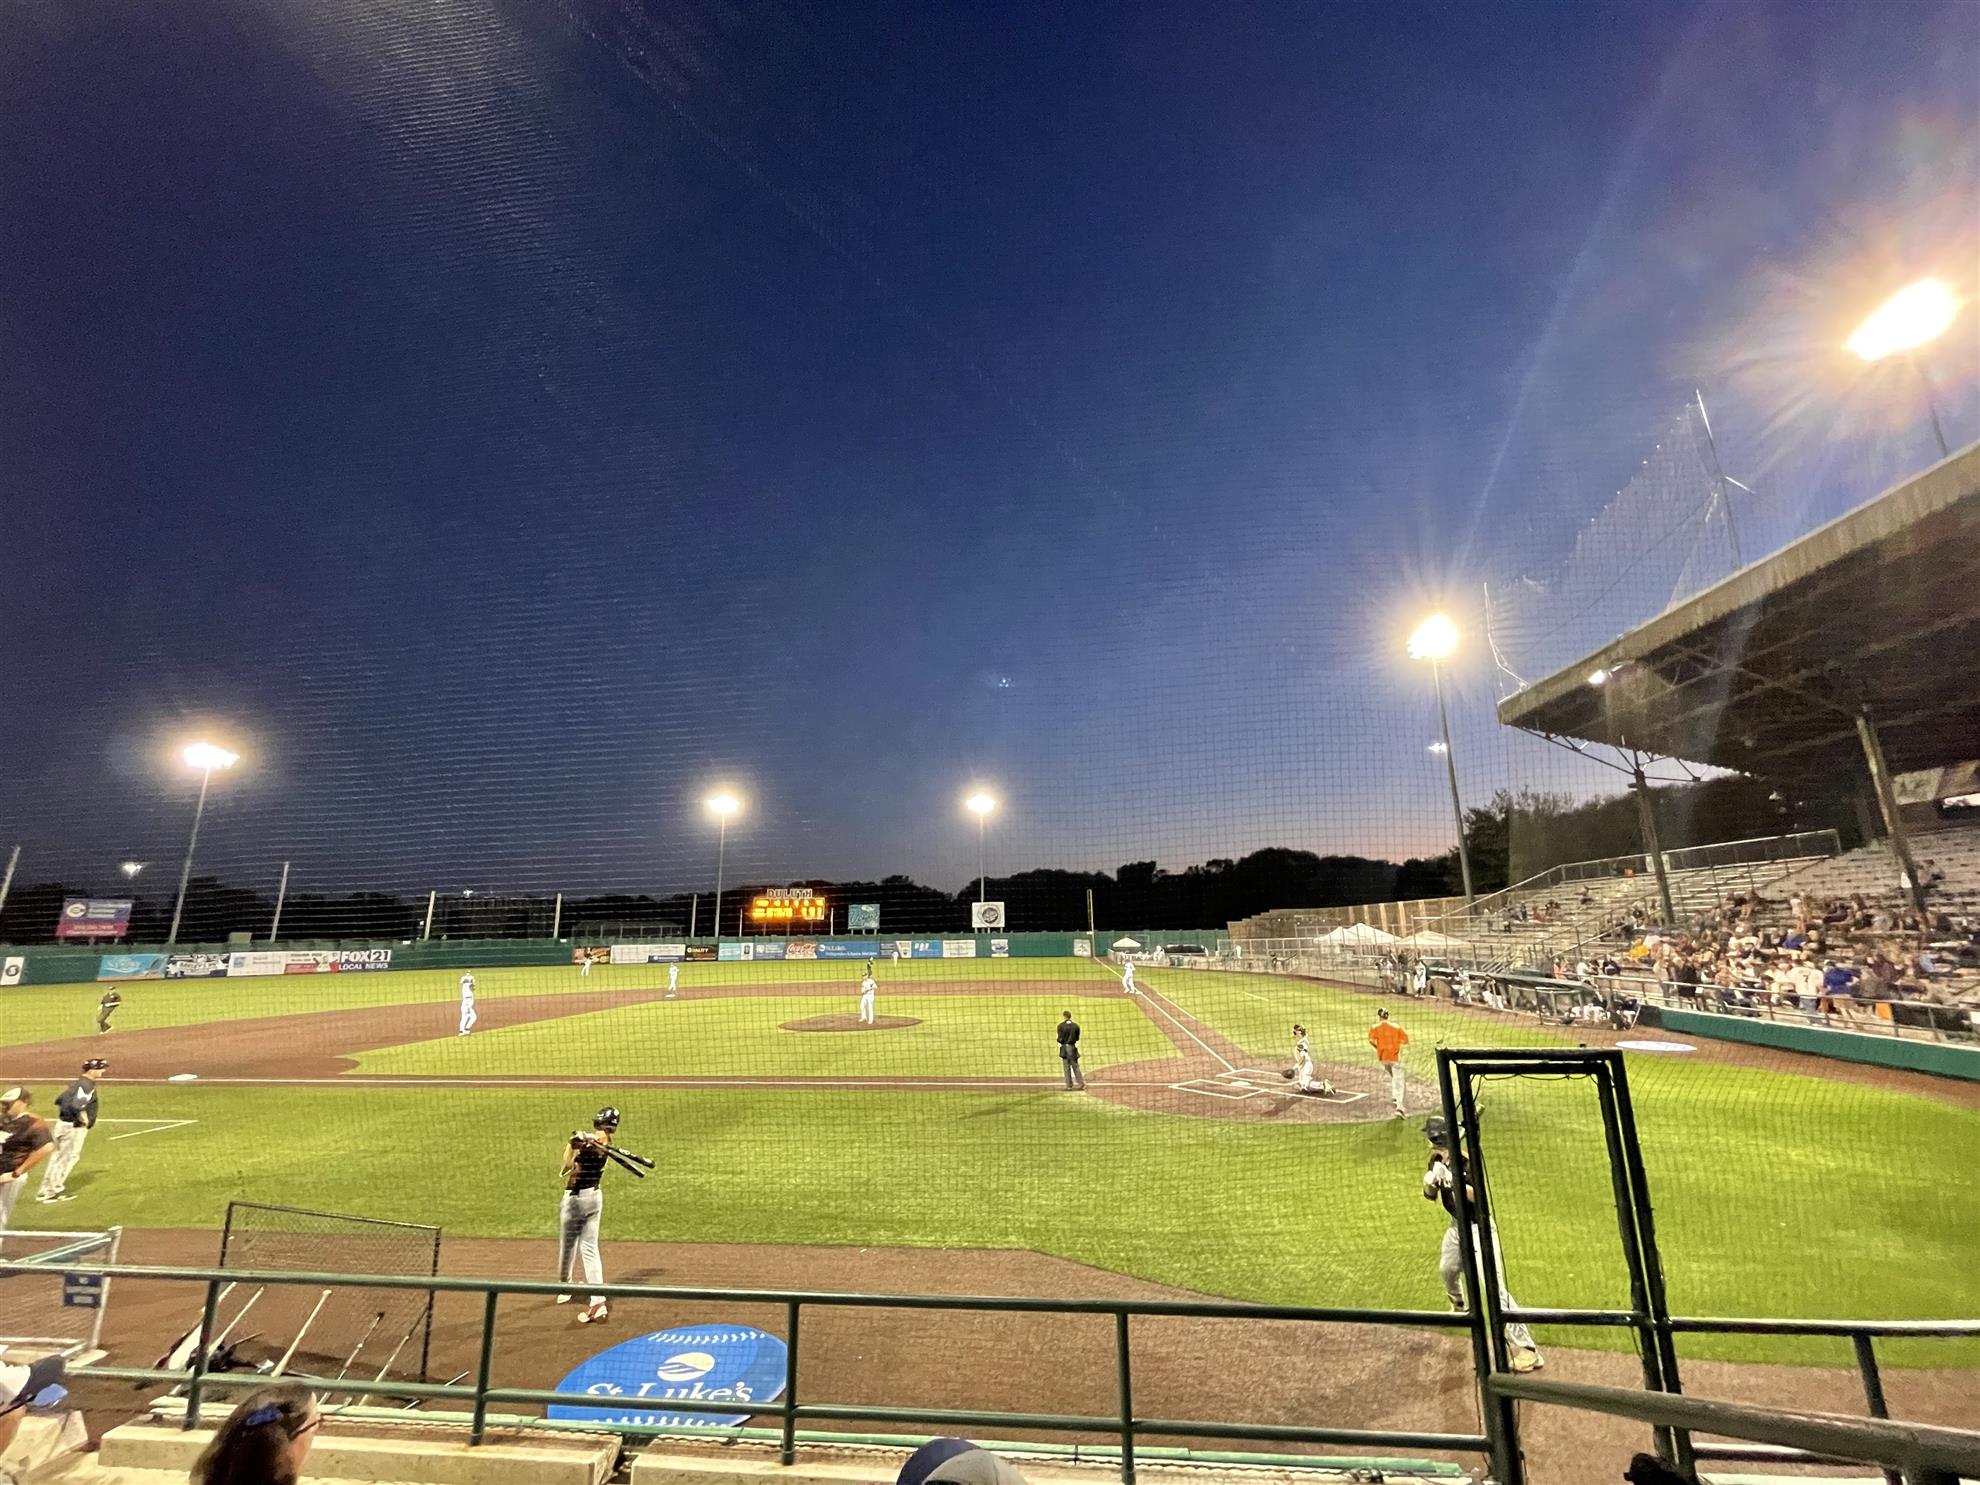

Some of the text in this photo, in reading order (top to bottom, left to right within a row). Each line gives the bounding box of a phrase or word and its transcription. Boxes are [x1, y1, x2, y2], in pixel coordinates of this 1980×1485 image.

[341, 950, 391, 963] FOX 21
[365, 962, 389, 970] NEWS
